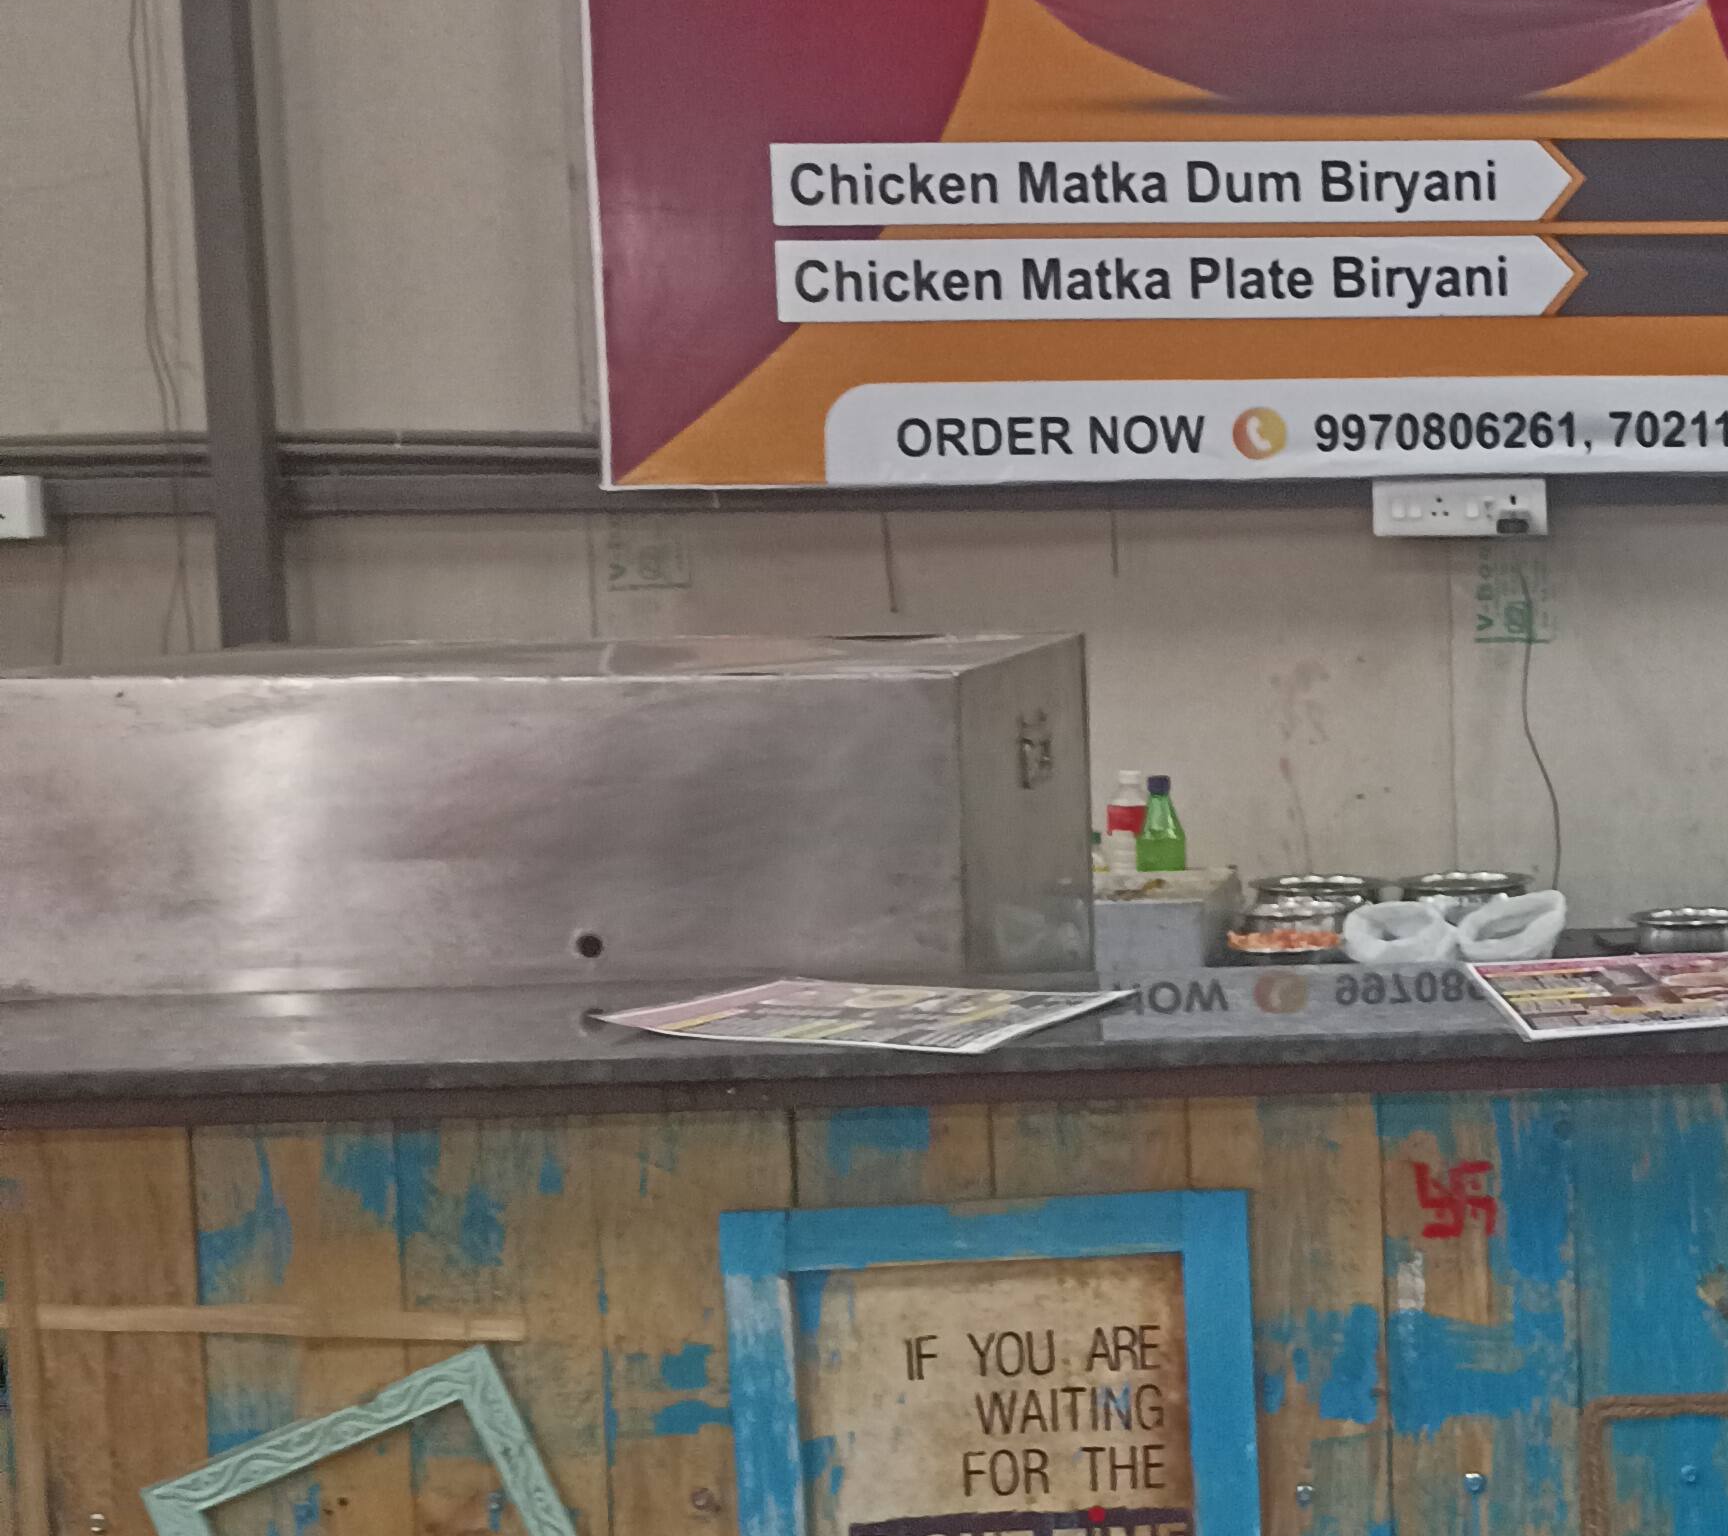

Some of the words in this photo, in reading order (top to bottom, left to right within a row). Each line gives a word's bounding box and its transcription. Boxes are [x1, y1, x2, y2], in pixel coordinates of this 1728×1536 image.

[791, 163, 997, 205] Chicken
[1019, 161, 1167, 203] Matka
[1187, 161, 1301, 203] Dum
[1321, 160, 1495, 213] Biryani
[796, 260, 1001, 303] Chicken
[1023, 258, 1170, 300] Matka
[1191, 257, 1313, 299] Plate
[1333, 255, 1507, 309] Biryani
[897, 417, 1073, 457] ORDER
[1090, 415, 1204, 454] NOW
[1315, 411, 1591, 452] 9970806261,
[904, 1335, 937, 1380] IF
[967, 1330, 1055, 1377] YOU
[1086, 1325, 1163, 1373] ARE
[976, 1384, 1164, 1435] WAITING
[963, 1449, 1049, 1496] FOR
[1081, 1444, 1166, 1492] THE
